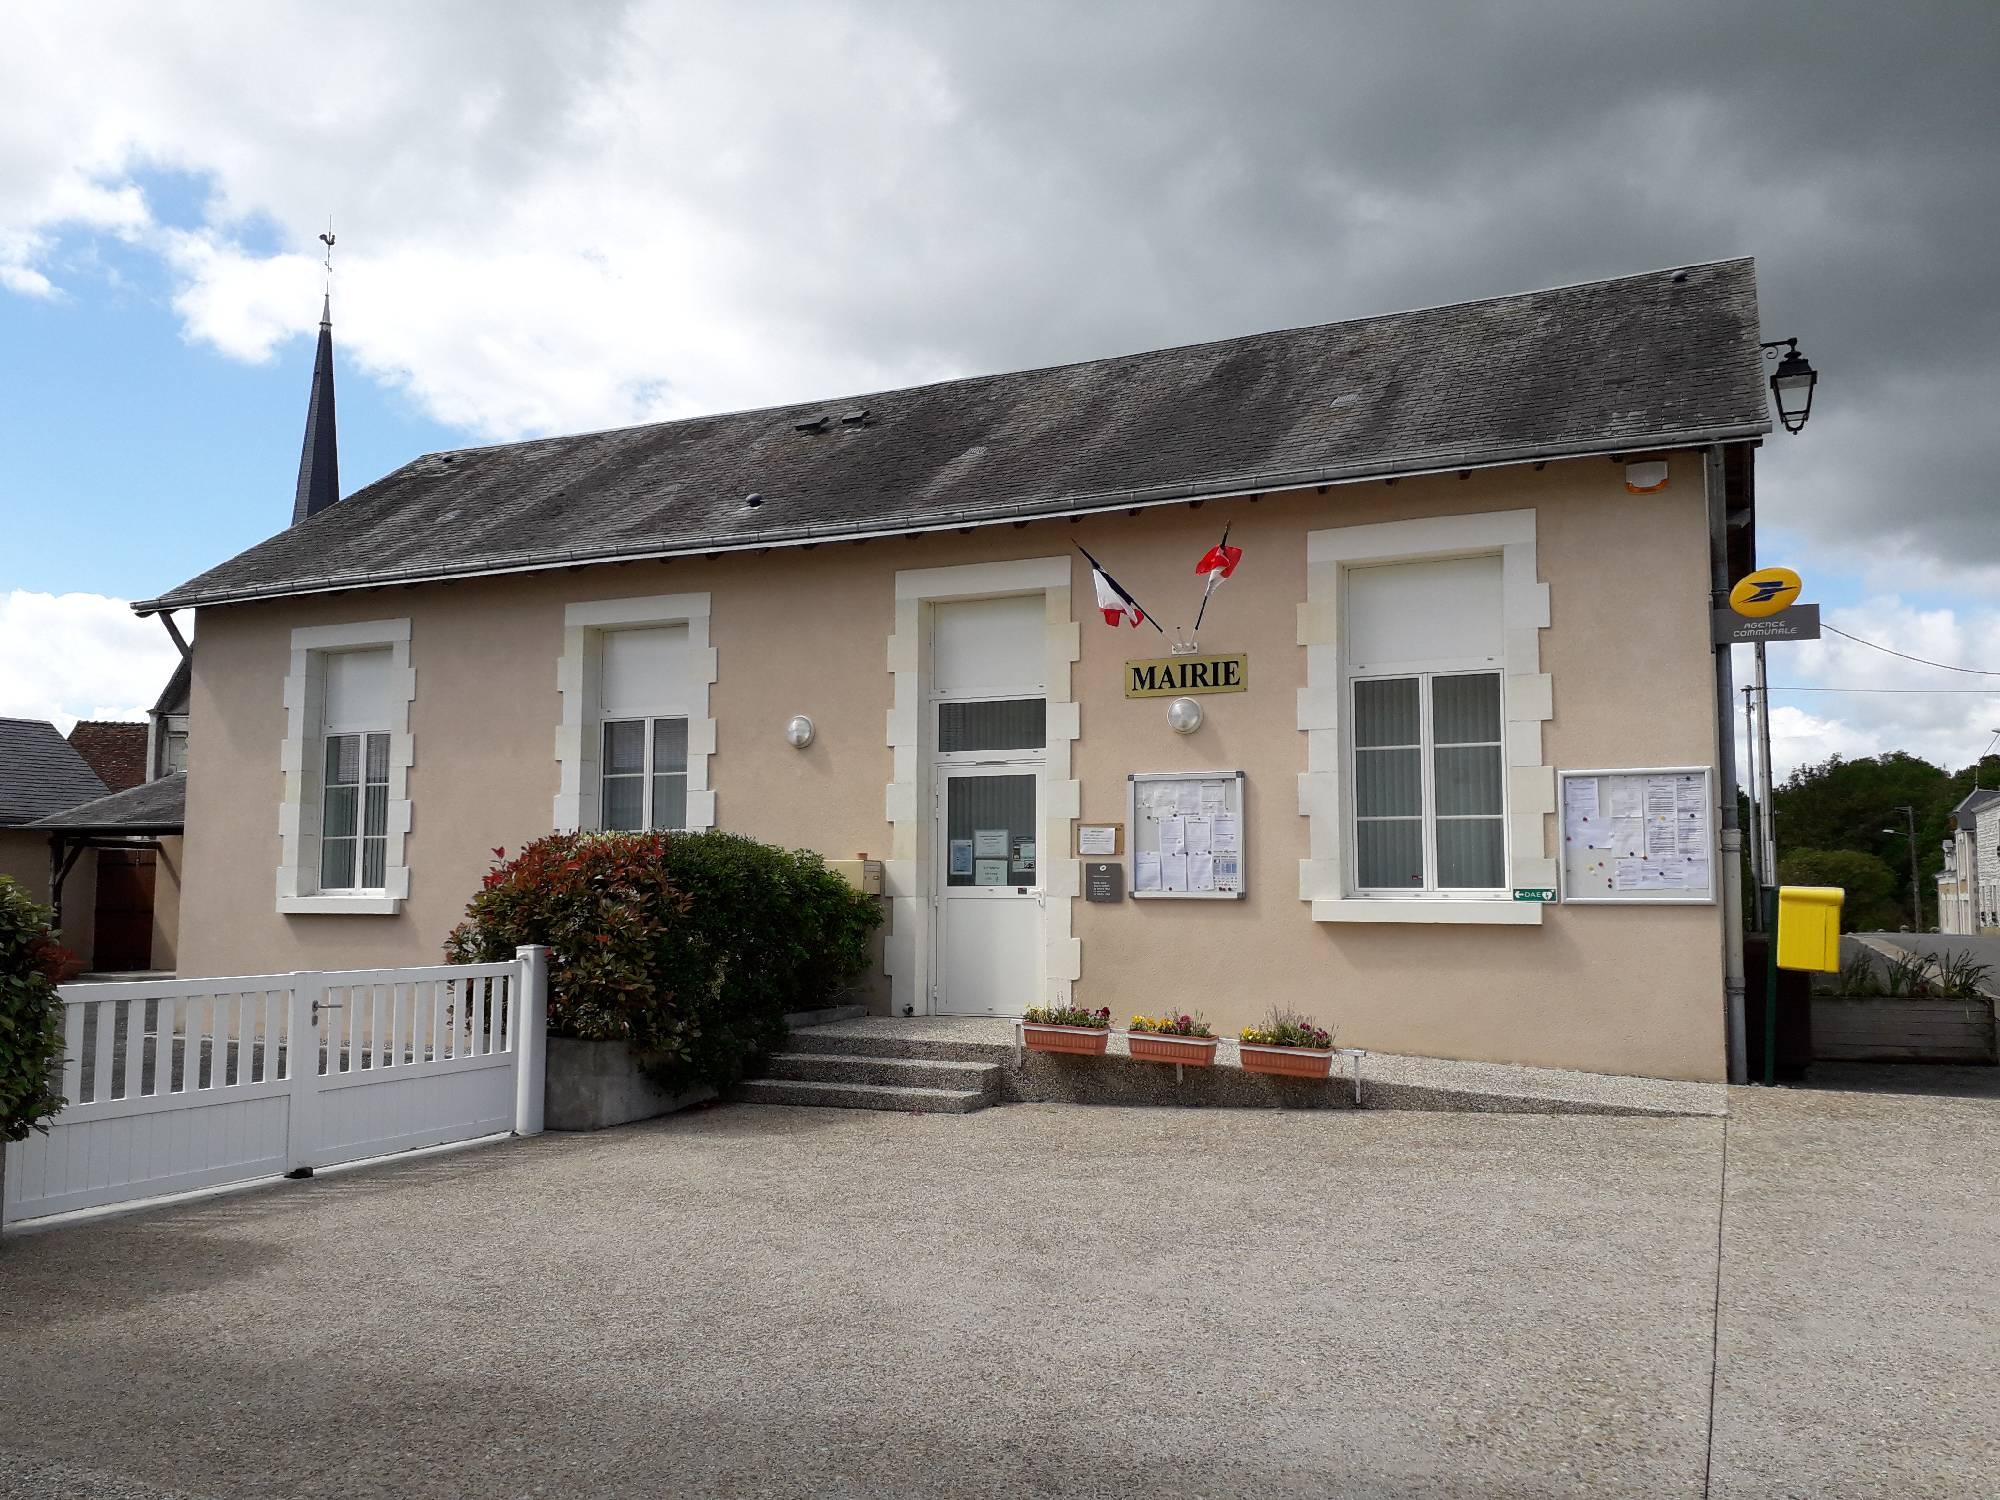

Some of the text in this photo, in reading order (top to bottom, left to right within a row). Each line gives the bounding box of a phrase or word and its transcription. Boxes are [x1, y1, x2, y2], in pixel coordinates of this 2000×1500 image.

[1743, 620, 1786, 629] AGENCE
[1733, 626, 1798, 638] COMMUNALE
[1131, 660, 1241, 692] MAIRIE
